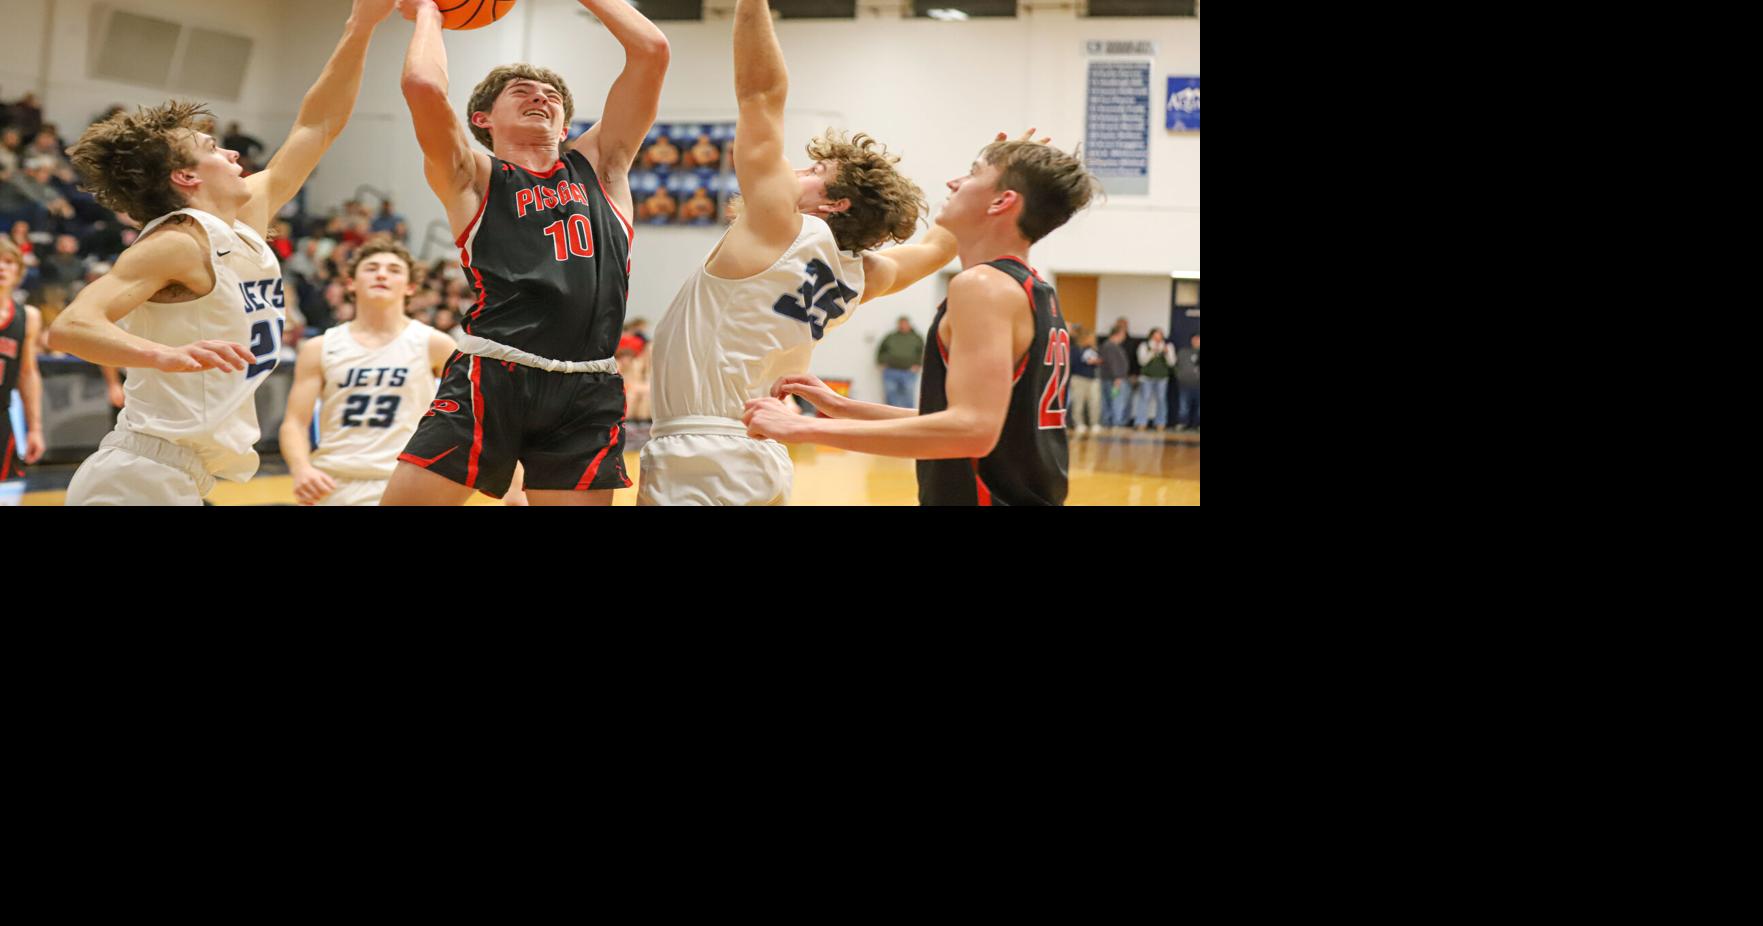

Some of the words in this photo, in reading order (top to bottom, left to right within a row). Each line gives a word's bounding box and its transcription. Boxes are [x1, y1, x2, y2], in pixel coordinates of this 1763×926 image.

[543, 213, 594, 261] 10
[238, 278, 285, 313] JETS
[773, 258, 858, 340] 35
[246, 319, 284, 379] 2
[338, 367, 408, 388] JETS
[1038, 327, 1070, 430] 22
[342, 394, 401, 428] 23
